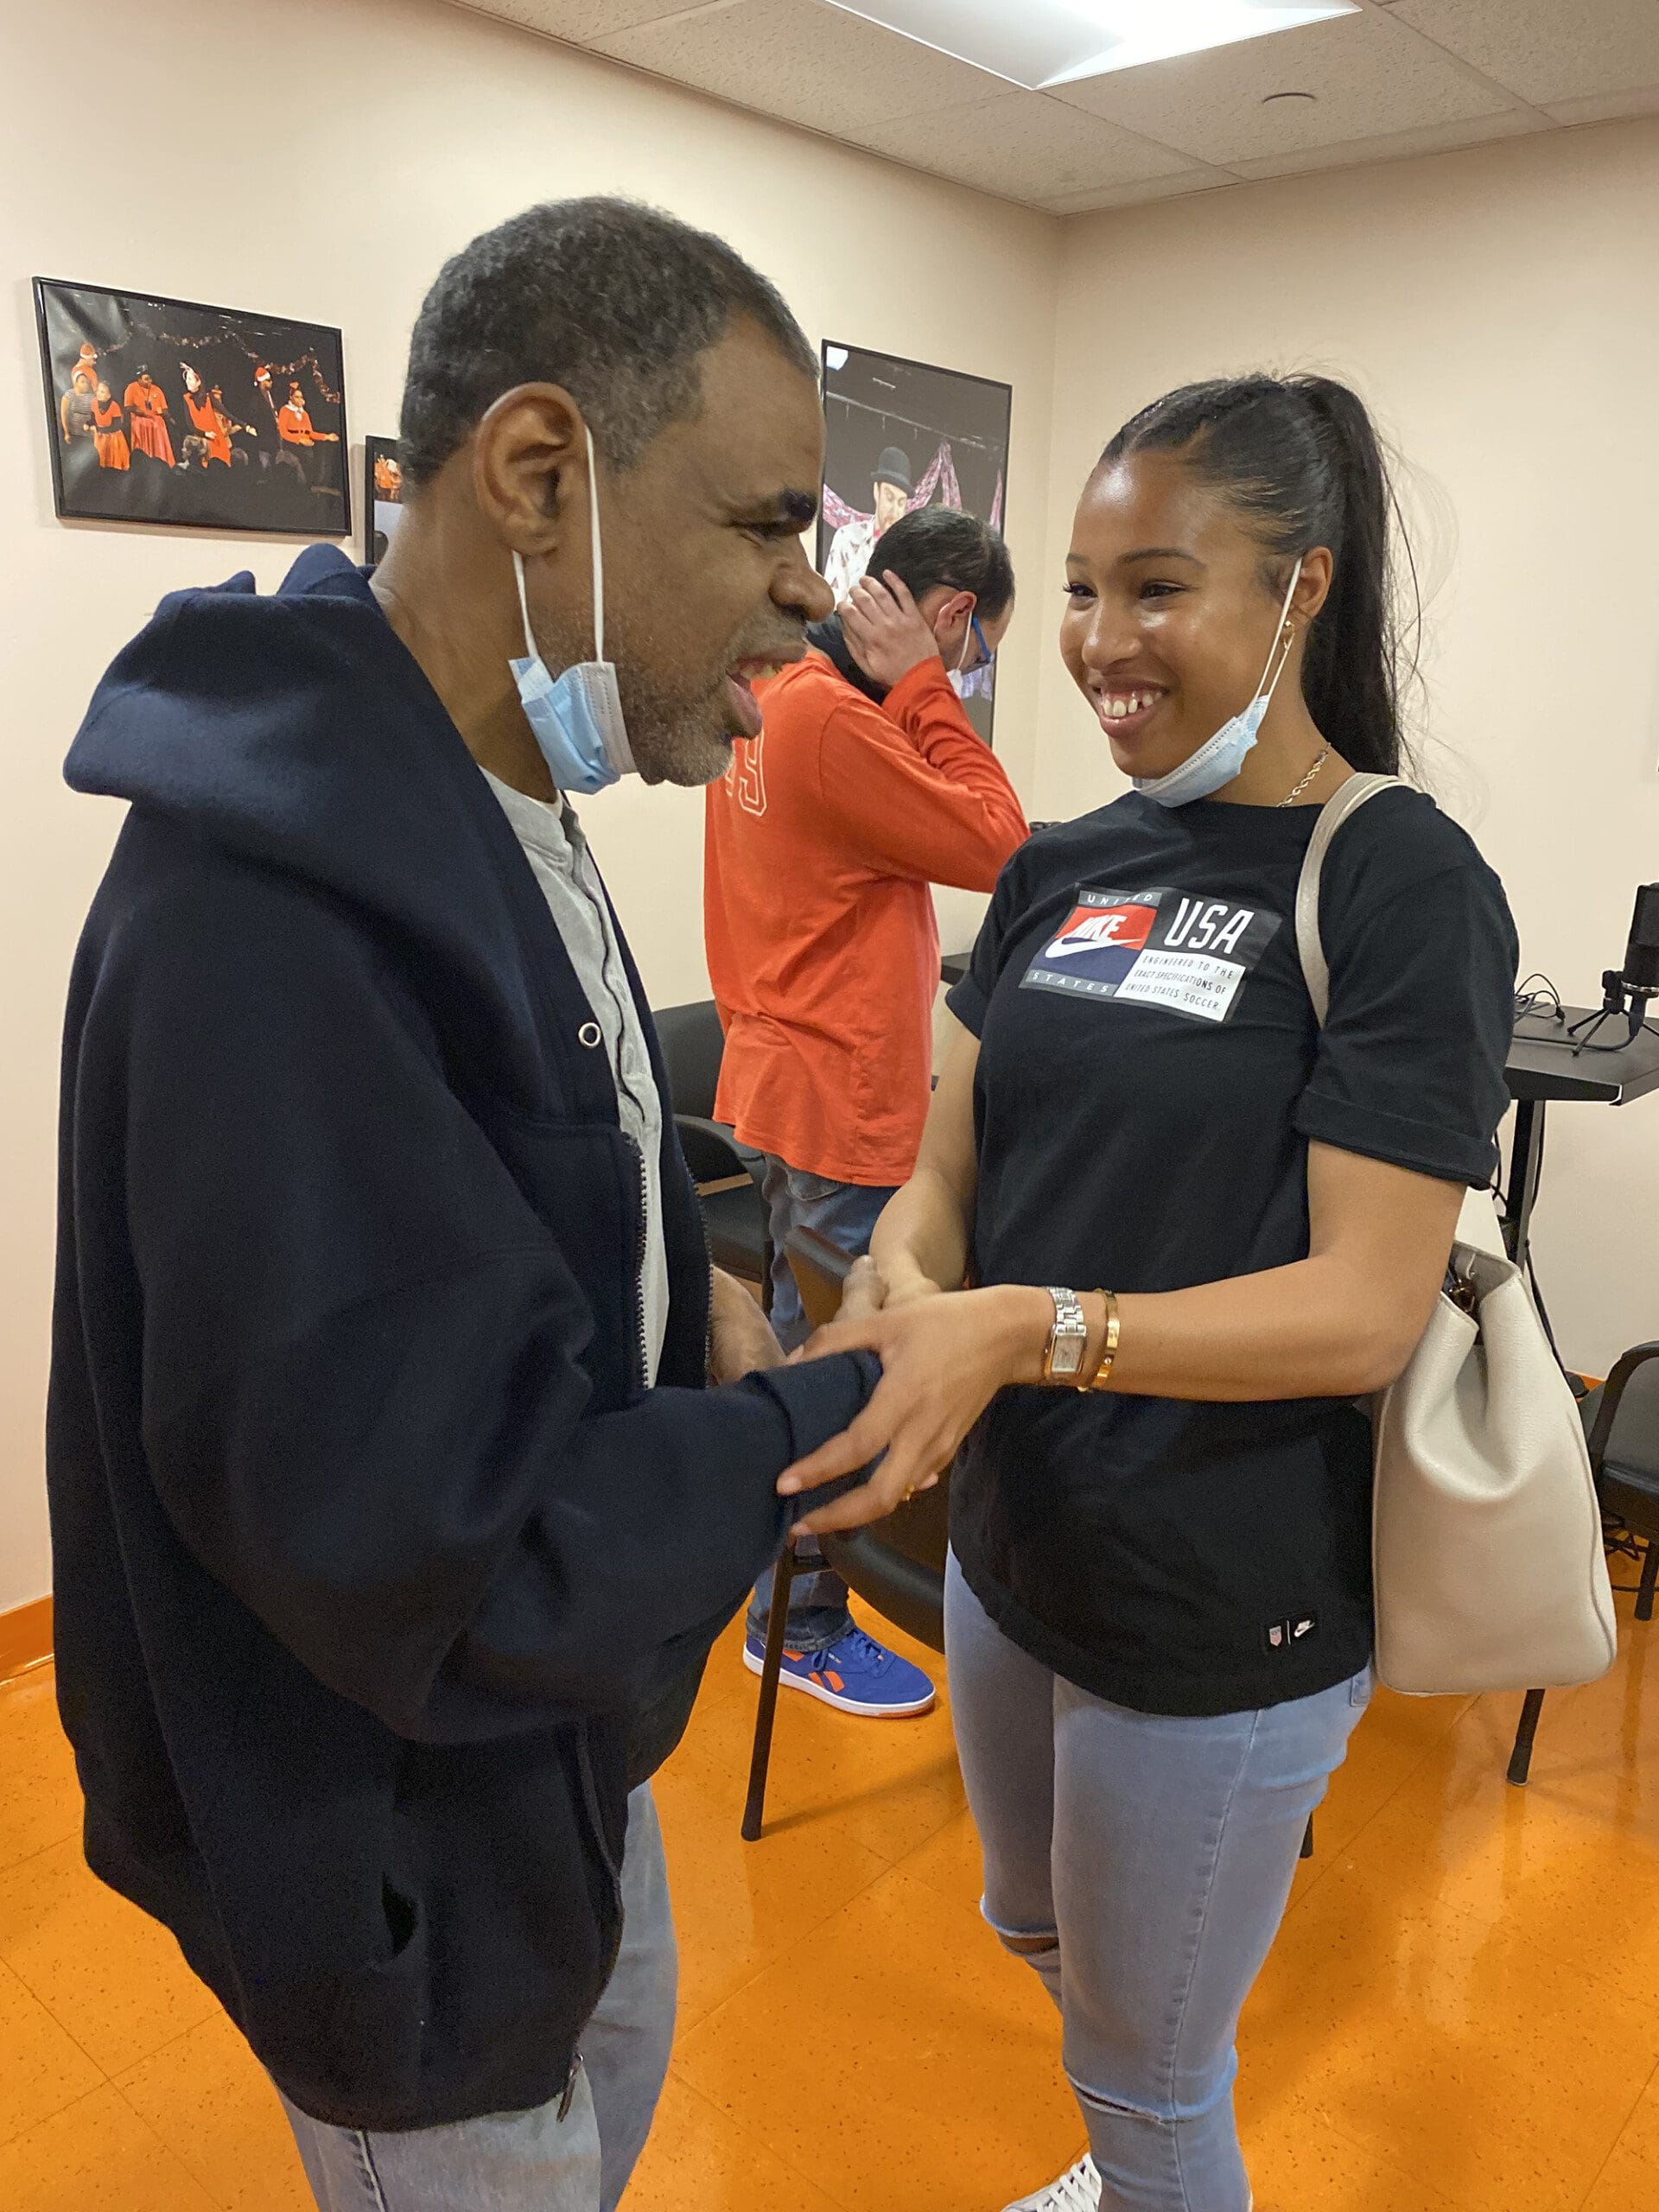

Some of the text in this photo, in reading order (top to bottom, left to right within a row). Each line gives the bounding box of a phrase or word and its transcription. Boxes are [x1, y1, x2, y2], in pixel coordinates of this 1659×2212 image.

[1087, 893, 1153, 905] UNITED
[1064, 914, 1128, 941] NIKE
[1164, 898, 1255, 954] USA
[1142, 956, 1234, 980] ENGINEERED TO THE
[1033, 972, 1109, 993] STATES
[1125, 983, 1151, 993] UNITED
[1152, 988, 1179, 998] STATES
[1134, 969, 1227, 995] EXACT SPECIFICATIONS OF
